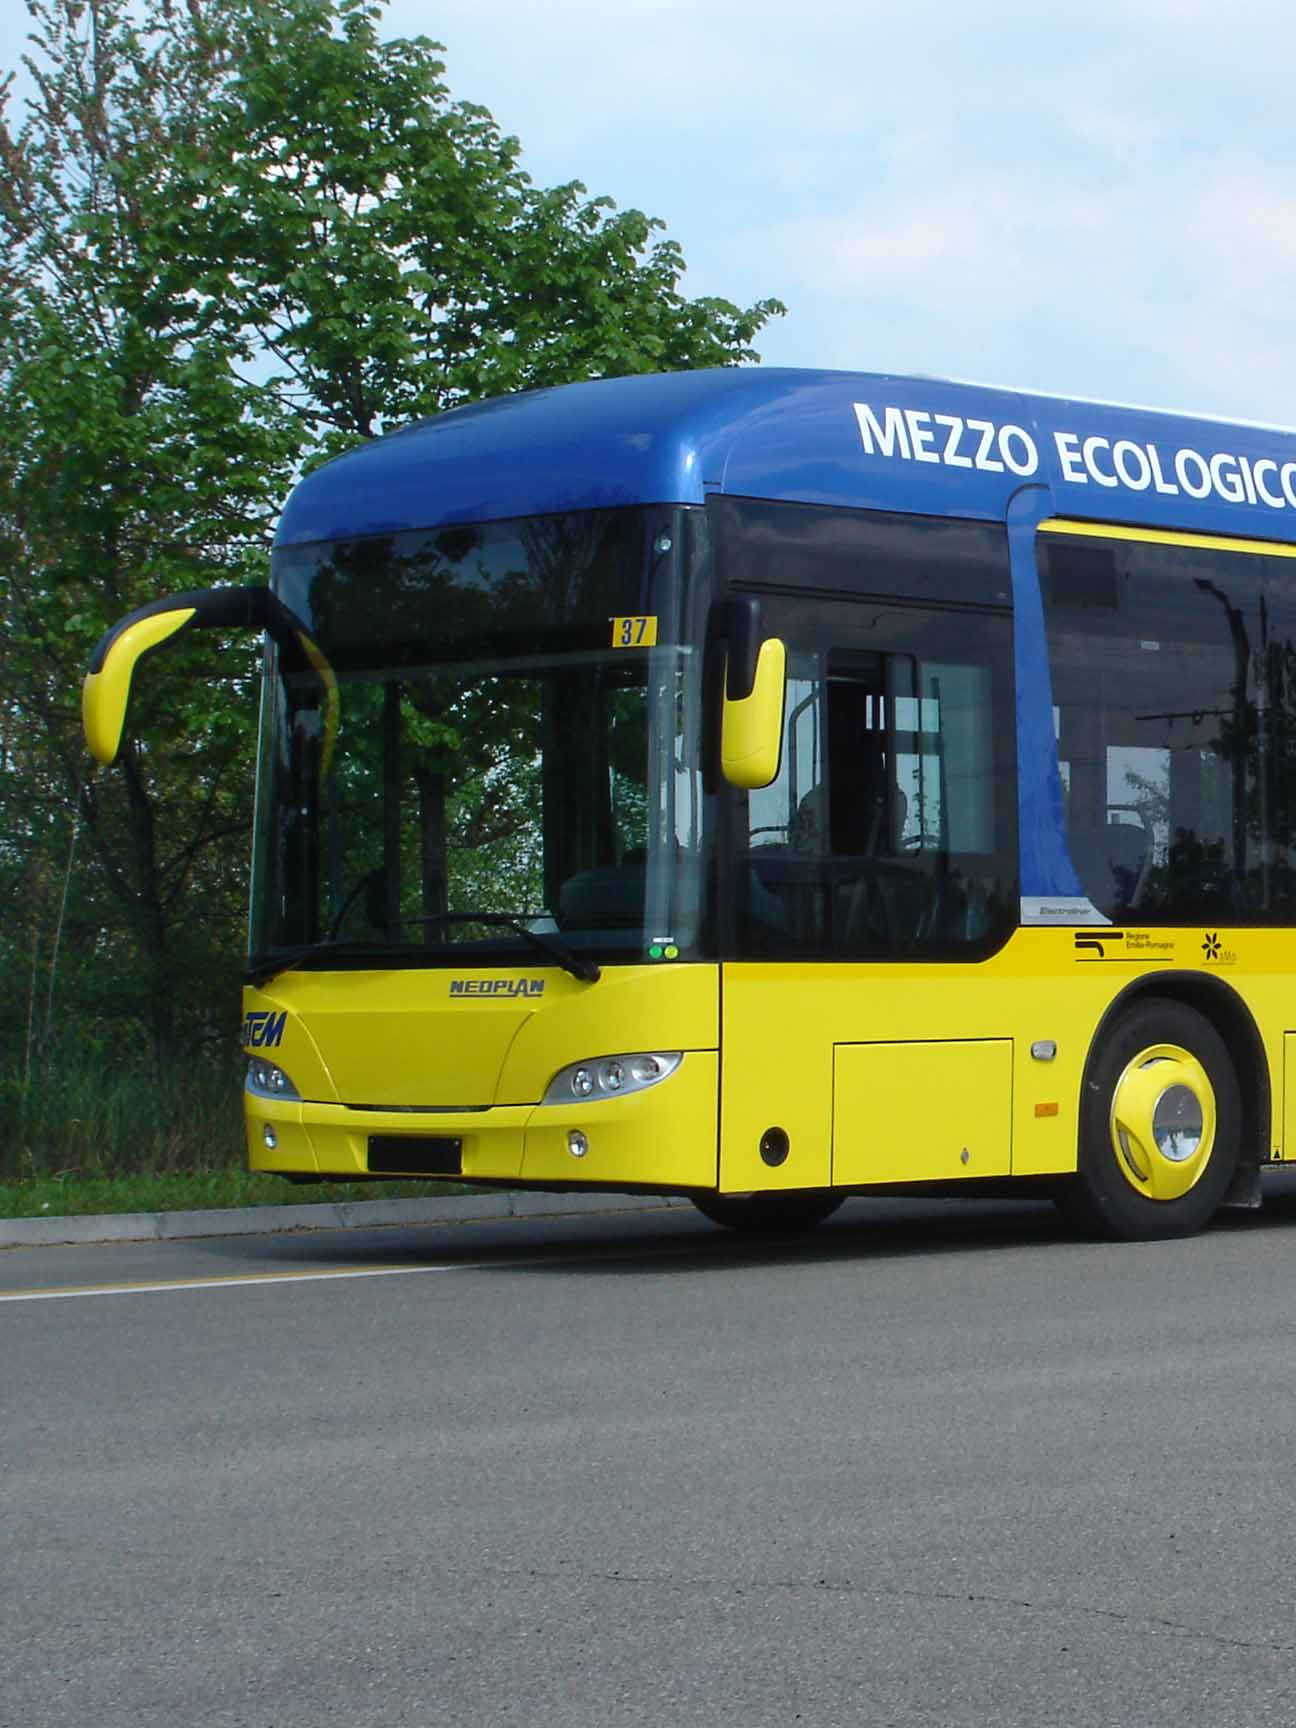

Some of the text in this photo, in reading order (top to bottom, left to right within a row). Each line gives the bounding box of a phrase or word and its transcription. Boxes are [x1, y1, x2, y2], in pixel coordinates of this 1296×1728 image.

[853, 402, 1039, 476] MEZZO
[621, 618, 648, 645] 37
[449, 978, 545, 997] NEOPLAN
